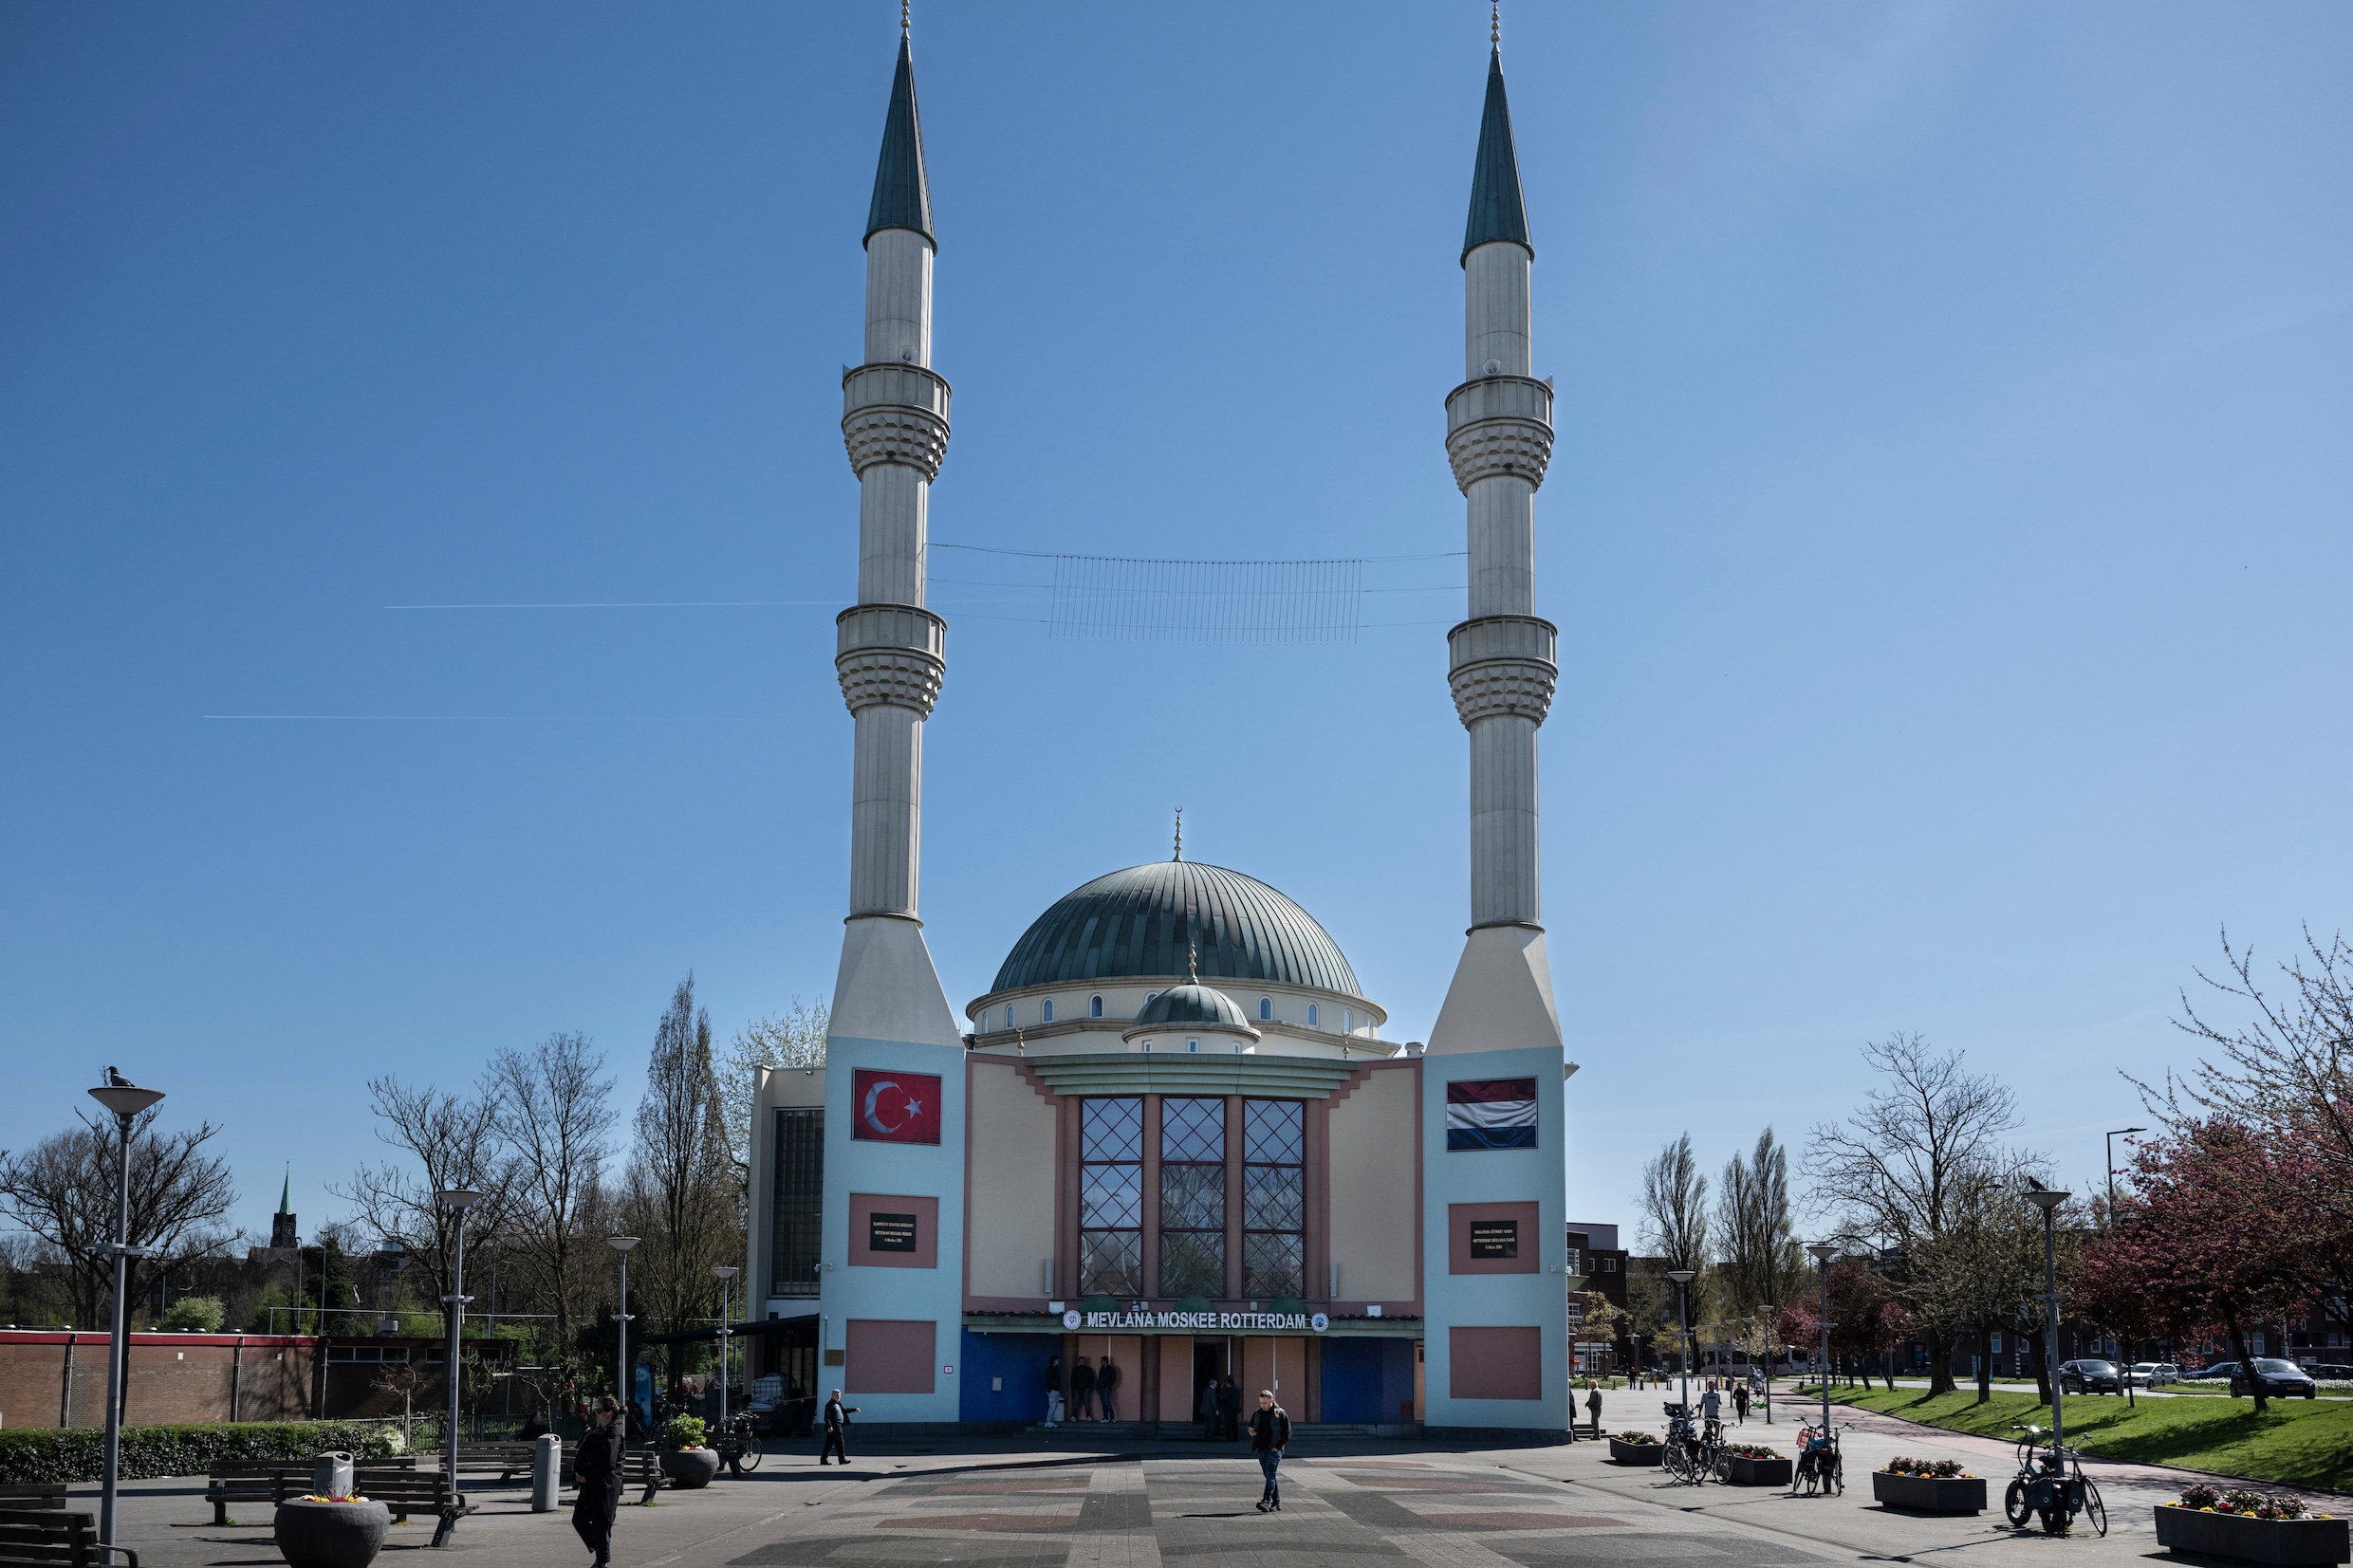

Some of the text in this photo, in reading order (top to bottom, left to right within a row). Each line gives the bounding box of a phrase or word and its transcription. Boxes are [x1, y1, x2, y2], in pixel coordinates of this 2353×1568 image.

[1087, 1311, 1155, 1327] MEVLANA
[1158, 1312, 1216, 1328] MOSKEE
[1220, 1313, 1306, 1329] ROTTERDAM
